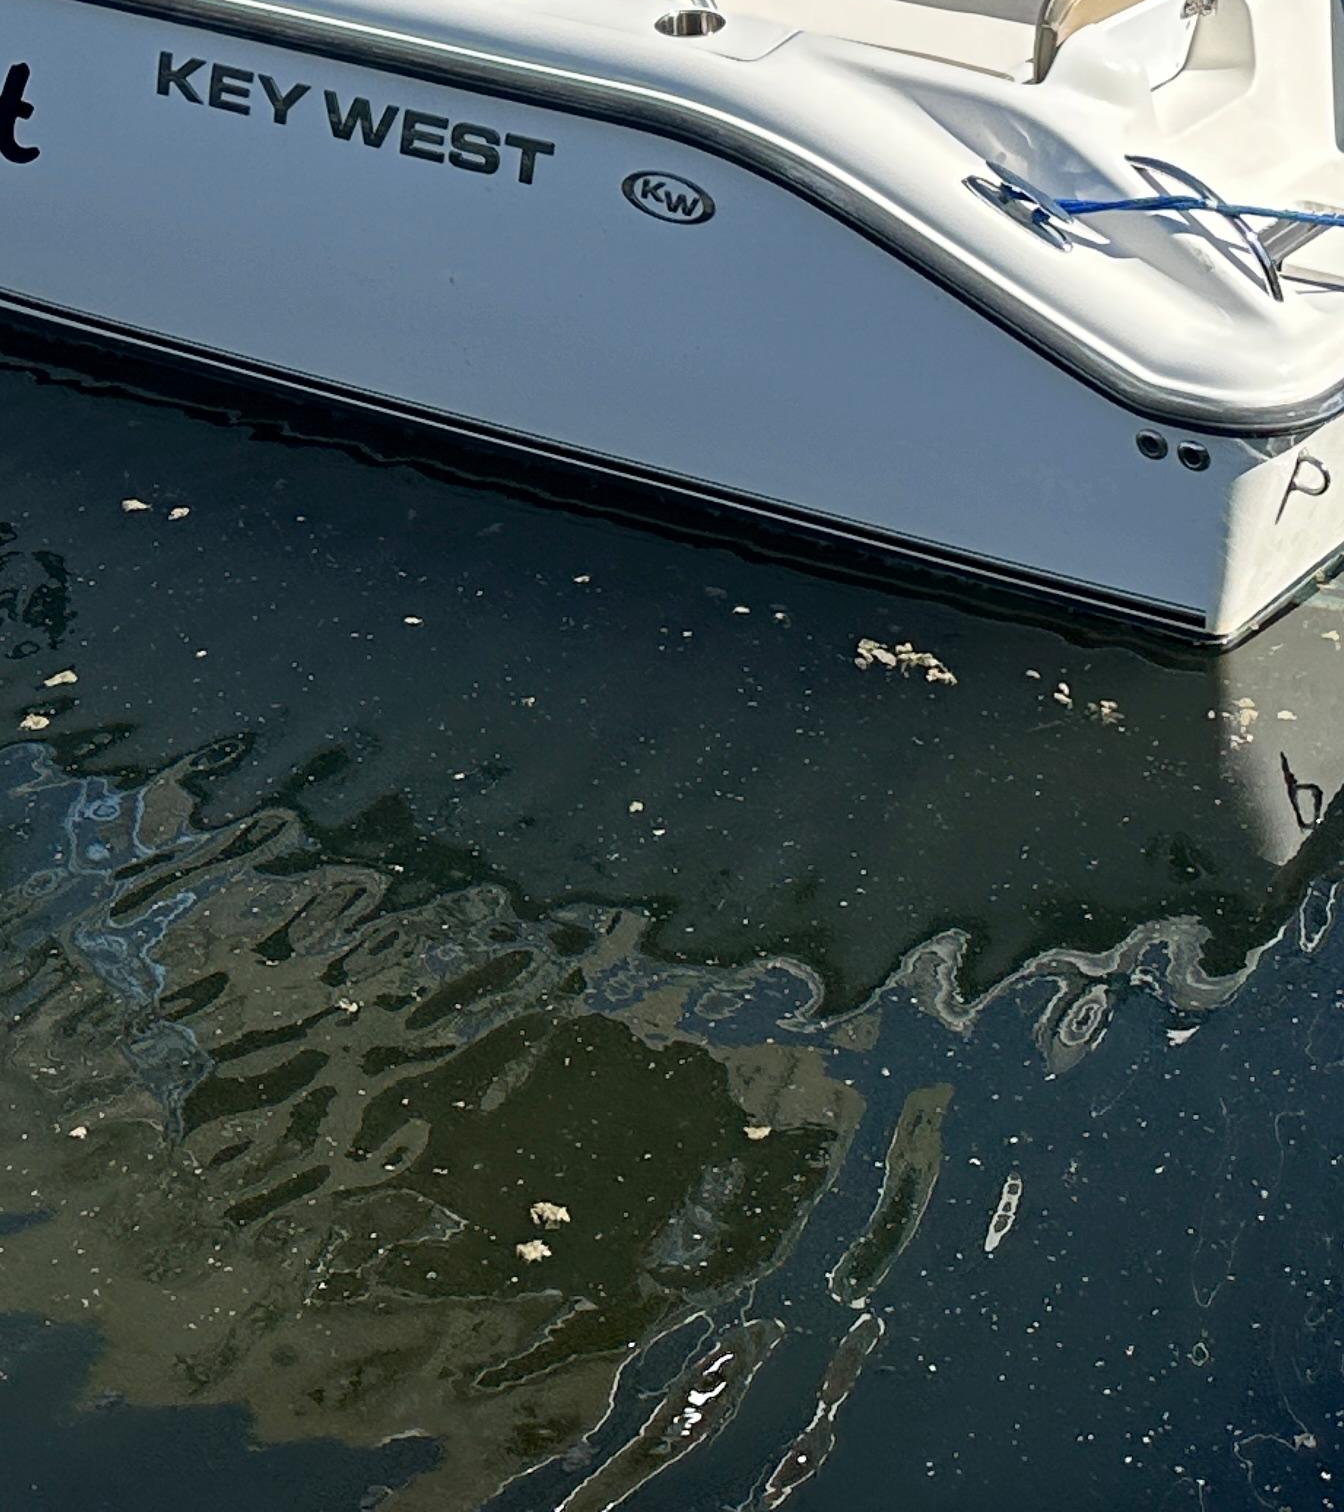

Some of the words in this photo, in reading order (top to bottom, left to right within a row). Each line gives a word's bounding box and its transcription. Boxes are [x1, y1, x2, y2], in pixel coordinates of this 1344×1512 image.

[156, 50, 312, 126] KEY
[323, 90, 556, 186] WEST
[640, 178, 701, 217] KW
